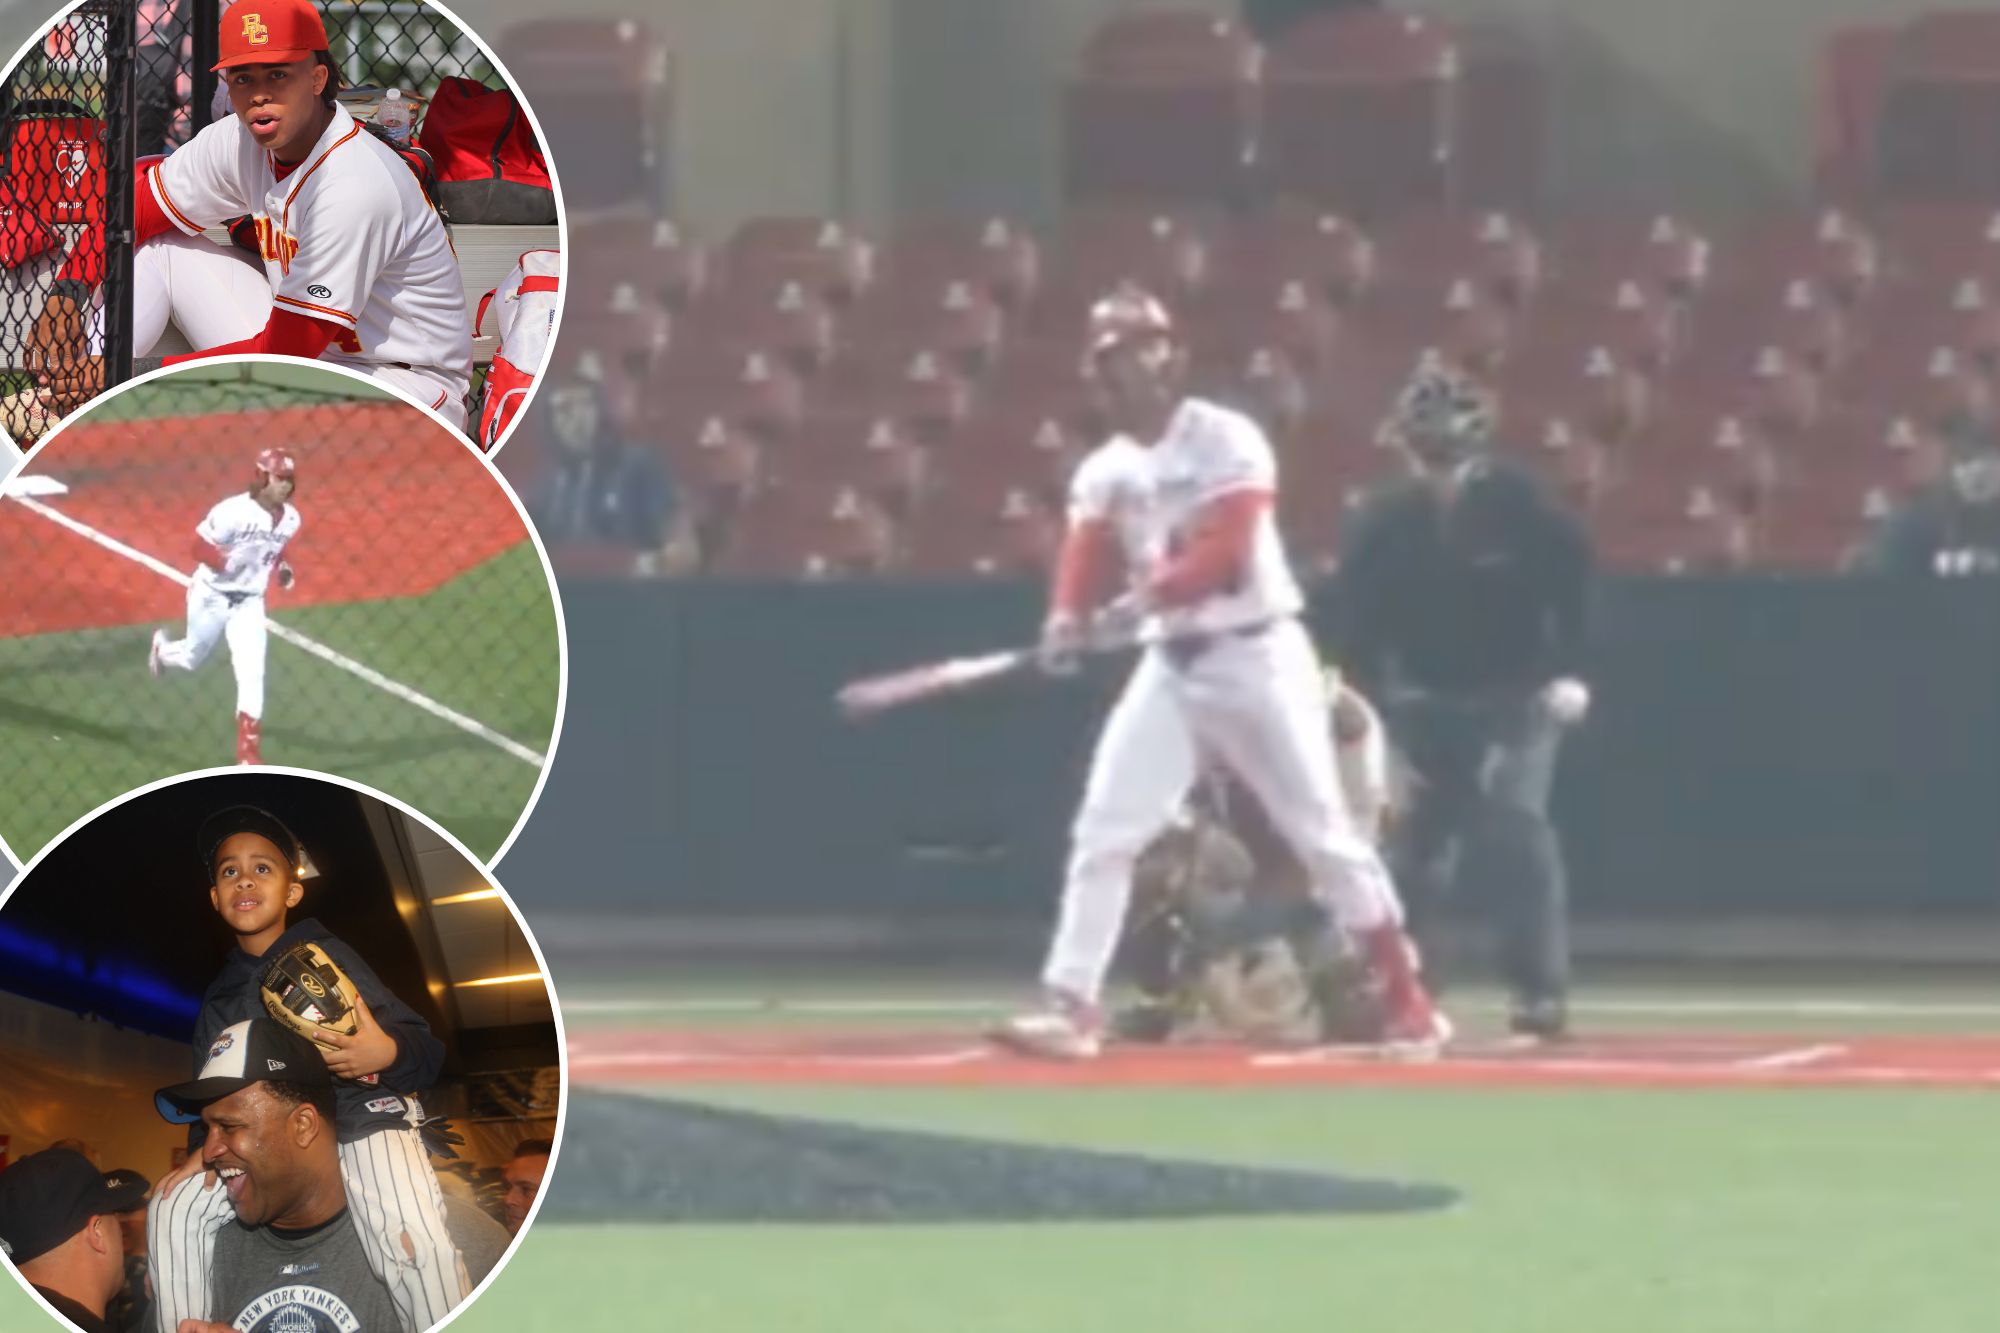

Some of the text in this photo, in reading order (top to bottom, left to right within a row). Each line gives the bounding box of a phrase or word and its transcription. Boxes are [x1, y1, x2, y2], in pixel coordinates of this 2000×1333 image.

[58, 201, 83, 209] PHIPS
[240, 1304, 263, 1328] NEW
[264, 1289, 296, 1307] YORK
